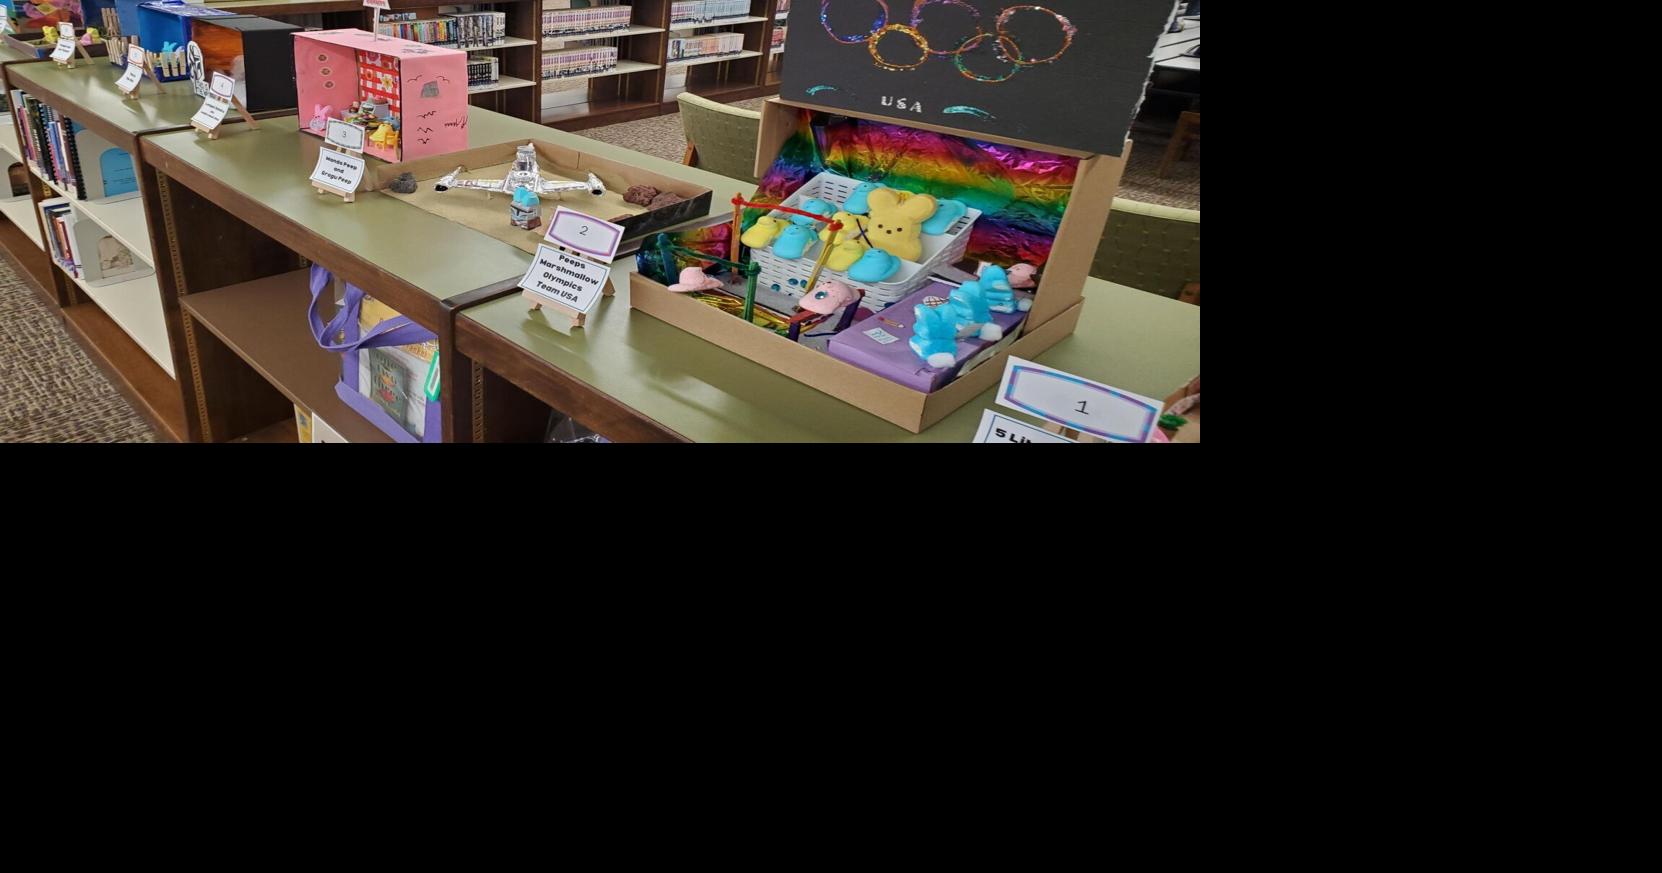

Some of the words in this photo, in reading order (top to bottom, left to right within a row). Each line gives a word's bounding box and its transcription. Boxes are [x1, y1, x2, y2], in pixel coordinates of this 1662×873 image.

[881, 96, 922, 113] USA
[343, 161, 358, 170] Peep
[338, 176, 352, 185] Peep
[579, 225, 589, 236] 2
[559, 254, 586, 269] Peeps
[540, 258, 599, 286] Marshmallow
[543, 271, 582, 292] Olympics
[536, 280, 560, 295] Team
[560, 290, 578, 303] USA
[1074, 400, 1089, 415] 1
[995, 428, 1007, 438] 5
